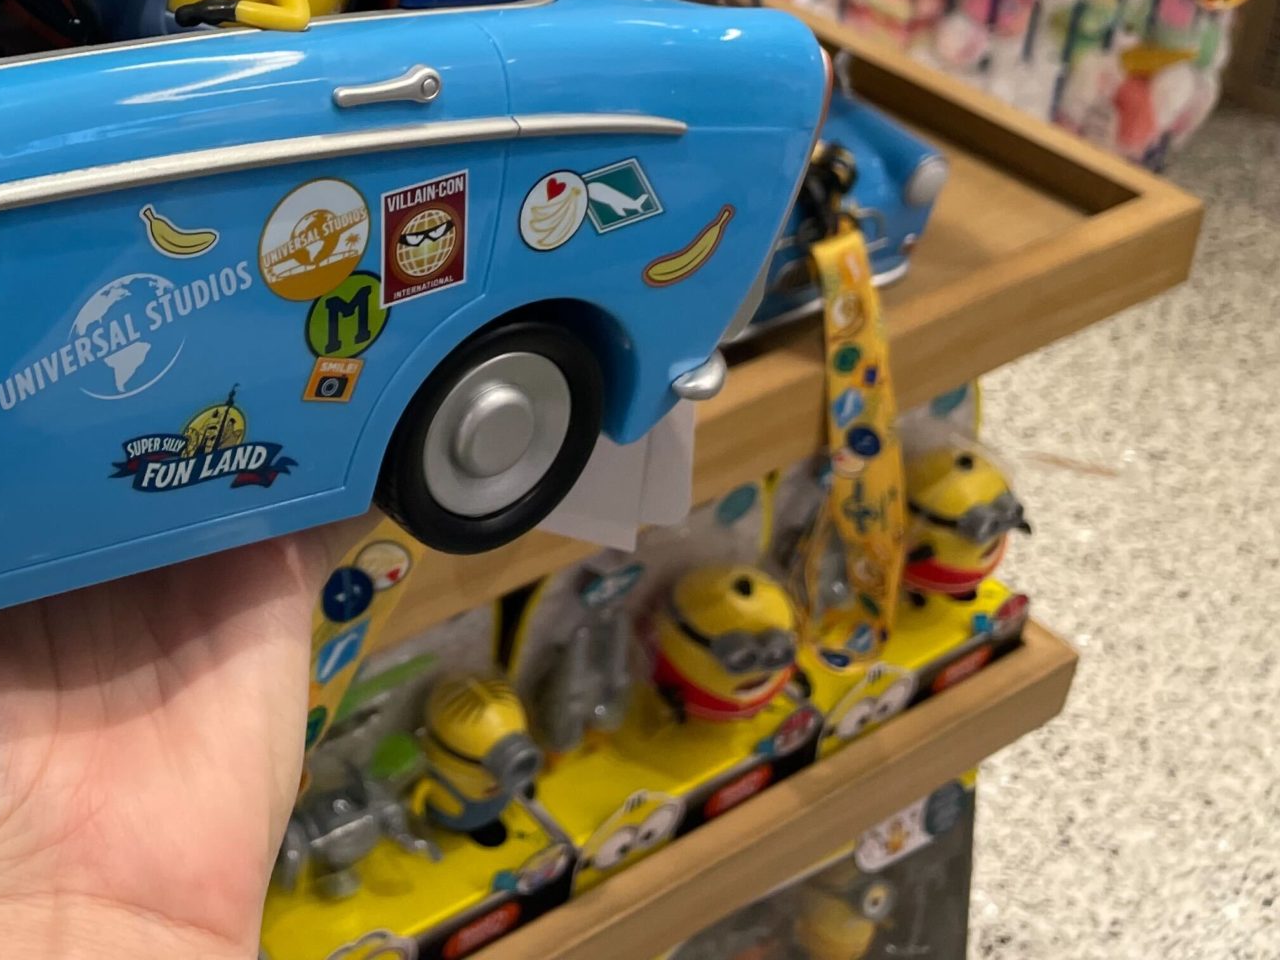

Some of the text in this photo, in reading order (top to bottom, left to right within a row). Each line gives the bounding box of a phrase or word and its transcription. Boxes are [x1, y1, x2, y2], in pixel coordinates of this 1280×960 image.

[387, 176, 464, 213] VILLAIN-CON
[262, 207, 368, 268] UNIVERSAL STUDIOS
[145, 260, 253, 331] STUDIOS
[393, 274, 455, 300] INTERNATIONAL
[324, 285, 372, 354] M
[320, 359, 358, 373] SMILE!
[126, 437, 187, 458] SUPER SILLY
[141, 445, 268, 489] FUN LAND
